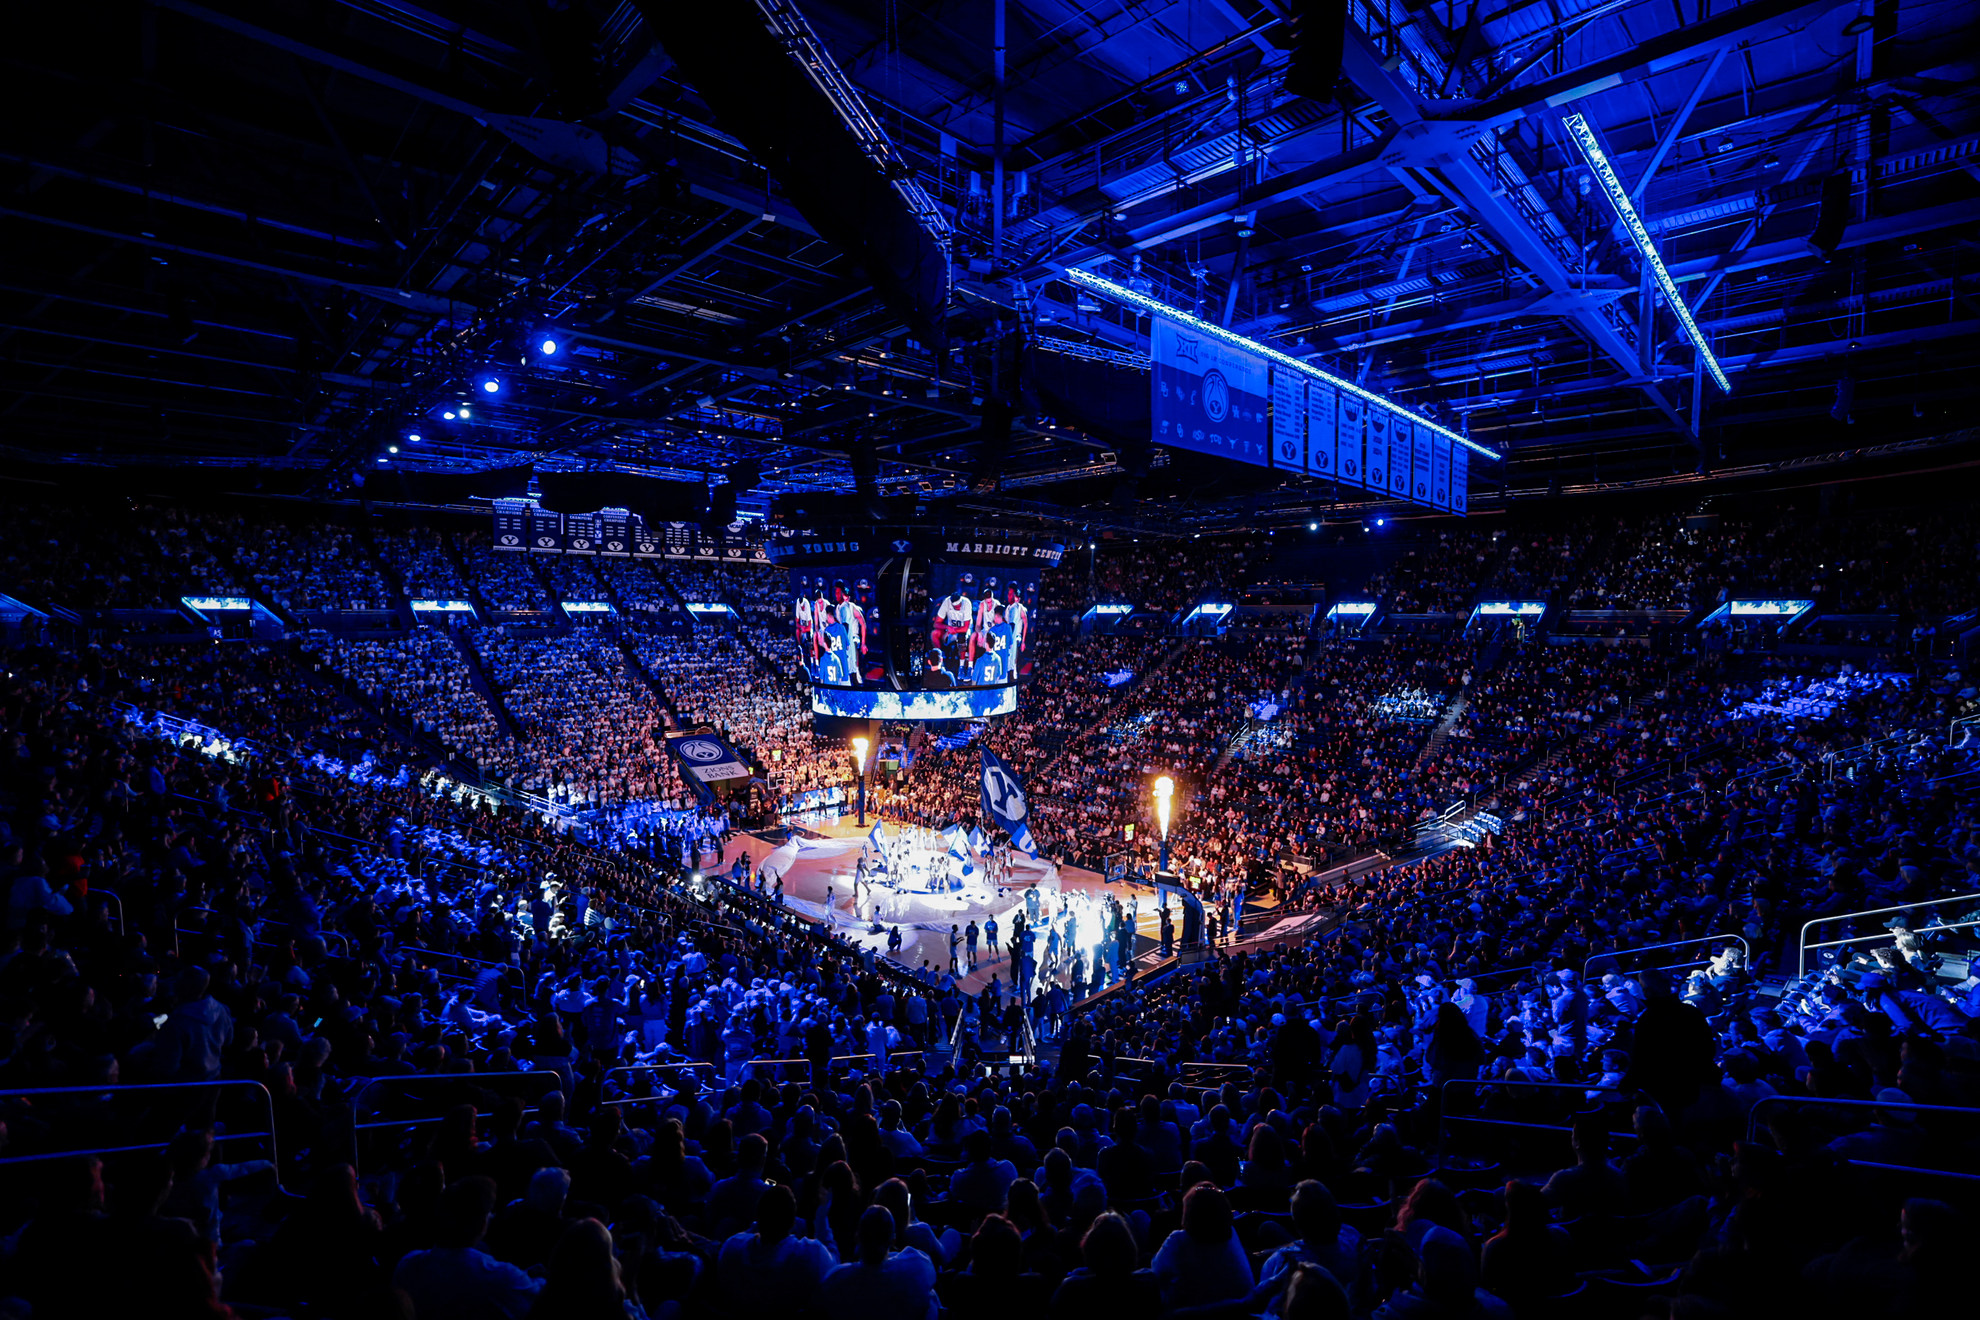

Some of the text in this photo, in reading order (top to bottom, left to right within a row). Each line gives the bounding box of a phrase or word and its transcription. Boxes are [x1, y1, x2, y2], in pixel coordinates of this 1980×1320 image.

[802, 541, 859, 554] YOUNG
[945, 542, 1029, 556] MARRIOTT
[951, 619, 962, 627] 50
[830, 635, 843, 651] 24
[994, 634, 1006, 651] 24
[827, 665, 837, 682] 51
[984, 665, 995, 682] 51
[703, 765, 735, 774] ZIONS
[707, 770, 738, 779] BANK
